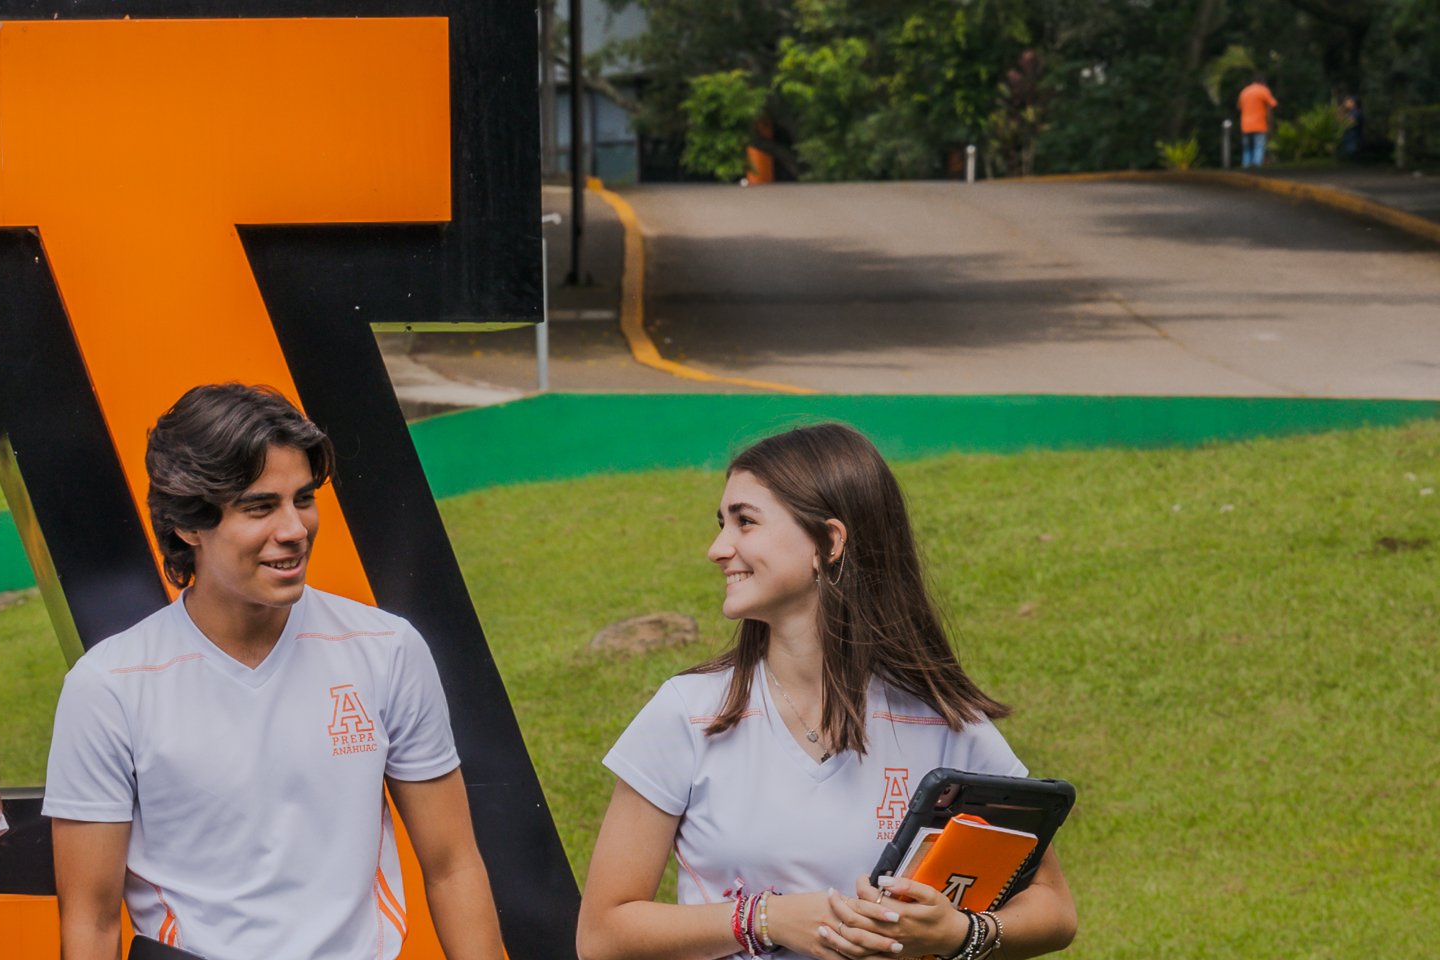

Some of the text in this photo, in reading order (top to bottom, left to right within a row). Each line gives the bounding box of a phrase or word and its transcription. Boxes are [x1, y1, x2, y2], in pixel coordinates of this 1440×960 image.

[327, 684, 375, 736] A
[332, 733, 375, 746] PREPA
[876, 767, 910, 819] A
[879, 820, 901, 830] PRE
